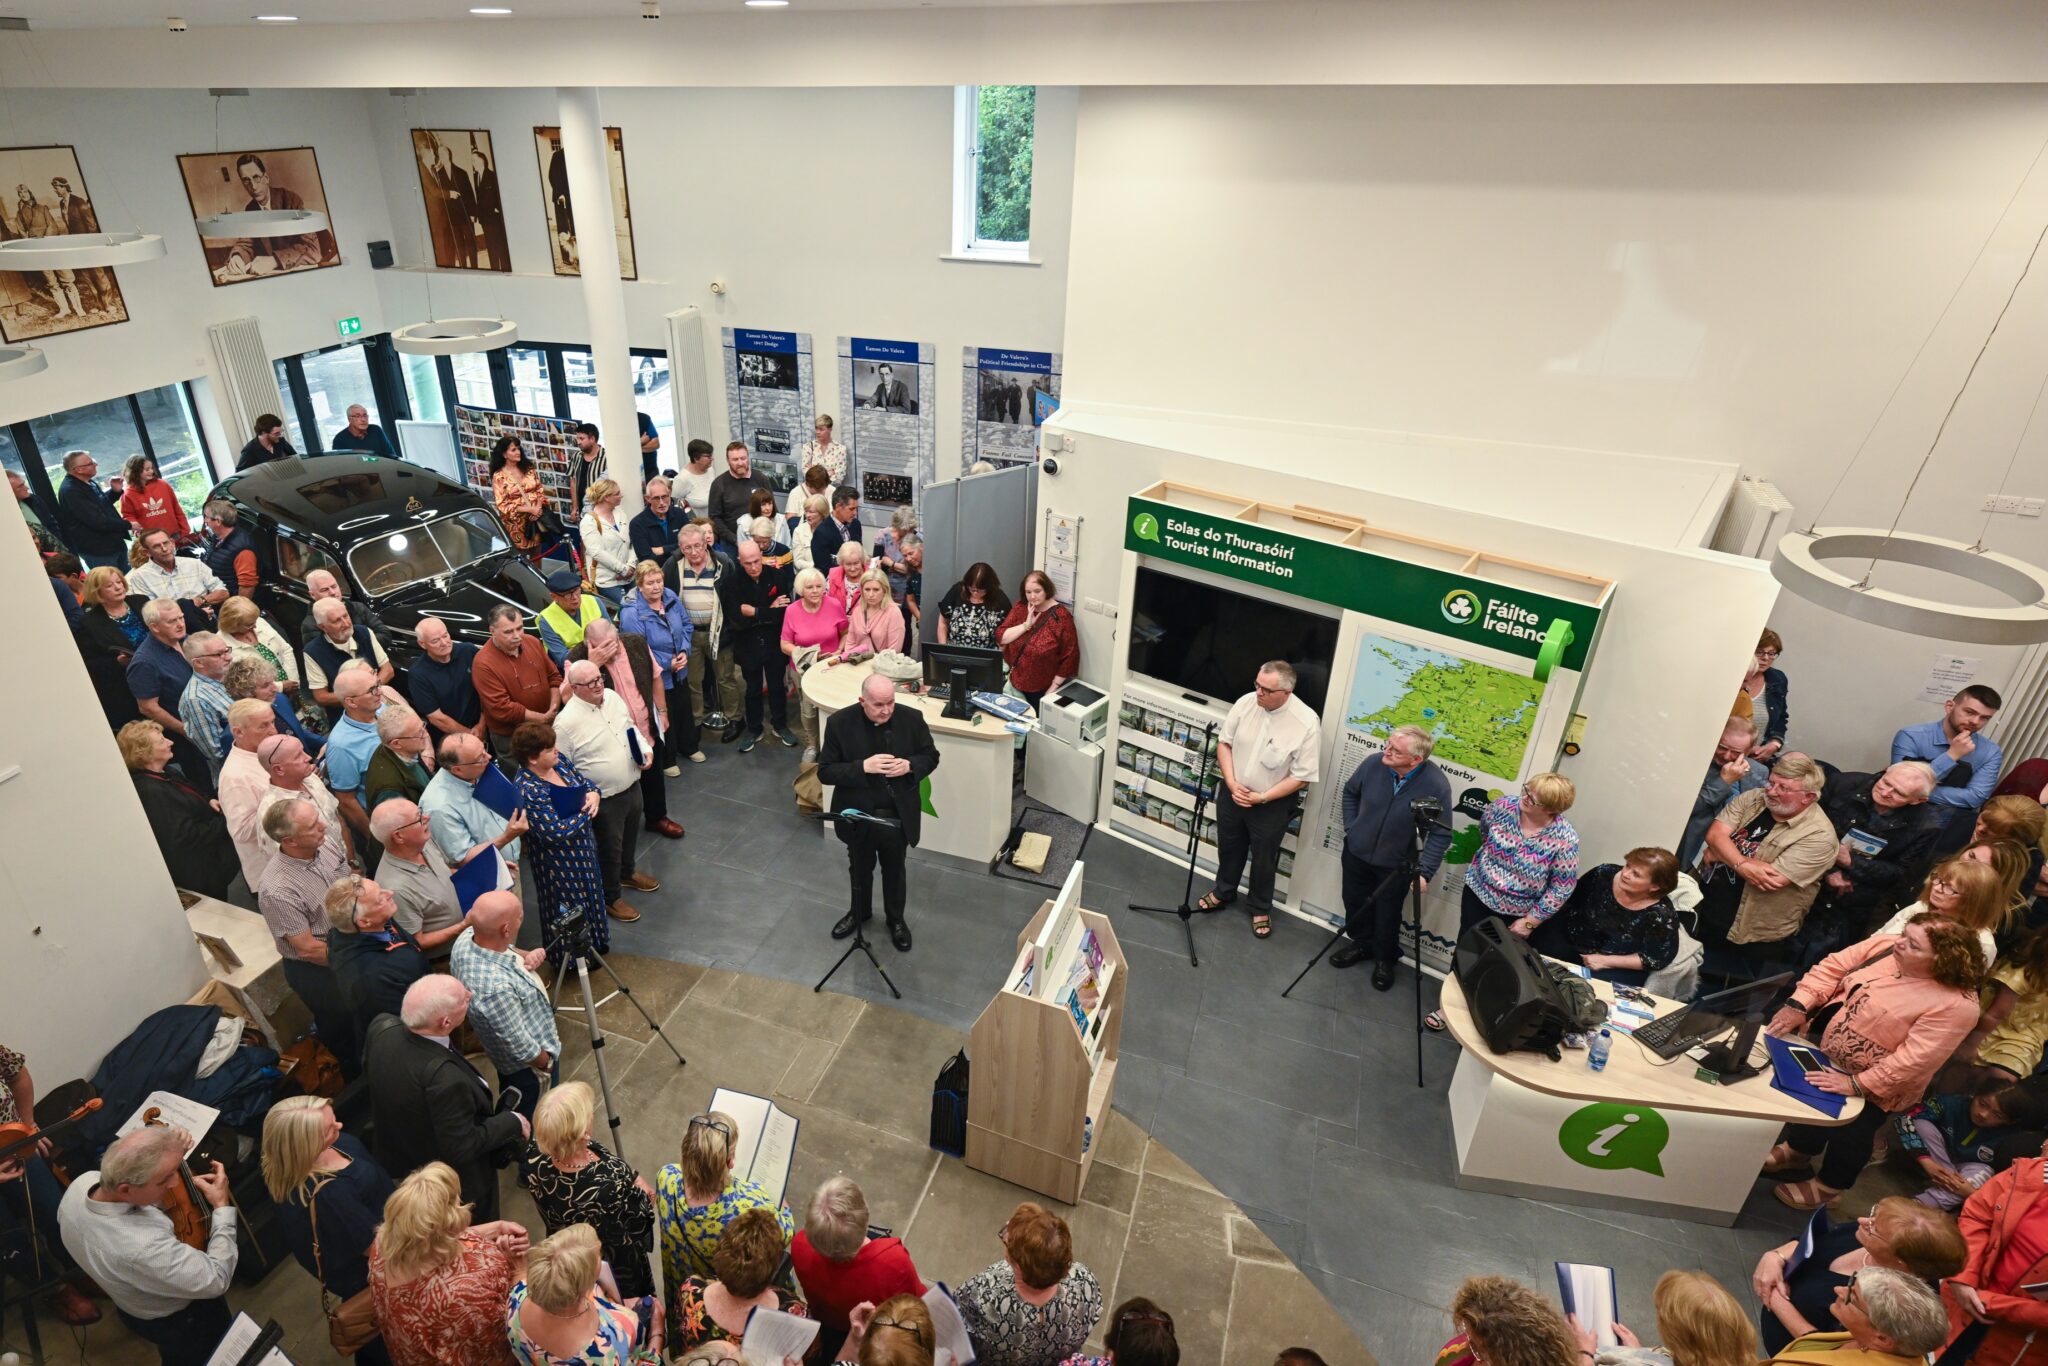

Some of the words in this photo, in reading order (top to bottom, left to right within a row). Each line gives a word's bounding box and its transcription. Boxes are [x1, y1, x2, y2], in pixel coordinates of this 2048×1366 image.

[1166, 519, 1200, 536] Eolas
[1204, 528, 1221, 542] do
[1225, 533, 1295, 560] Thurasóirí
[1165, 536, 1209, 557] Tourist
[1212, 548, 1293, 578] Information
[1486, 599, 1539, 625] Fáilte
[1133, 696, 1145, 705] more
[1178, 712, 1194, 721] please
[1347, 733, 1377, 748] Things
[1440, 764, 1476, 782] Nearby
[1420, 940, 1448, 954] TLANTIC
